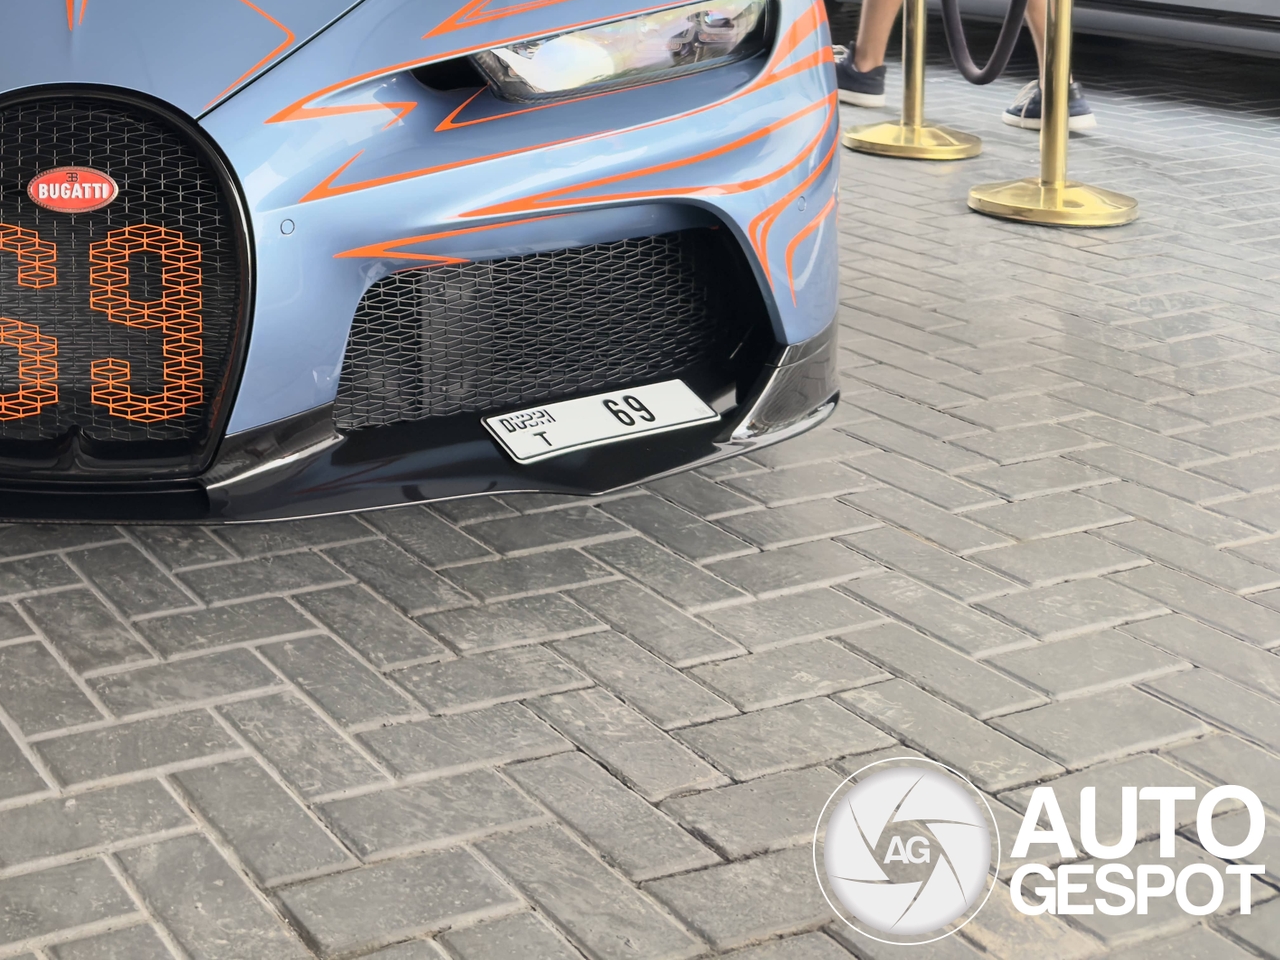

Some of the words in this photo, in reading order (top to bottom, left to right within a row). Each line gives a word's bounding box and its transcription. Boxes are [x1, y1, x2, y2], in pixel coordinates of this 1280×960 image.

[38, 183, 110, 199] BUGATTI
[603, 395, 656, 426] 69
[533, 431, 552, 446] T
